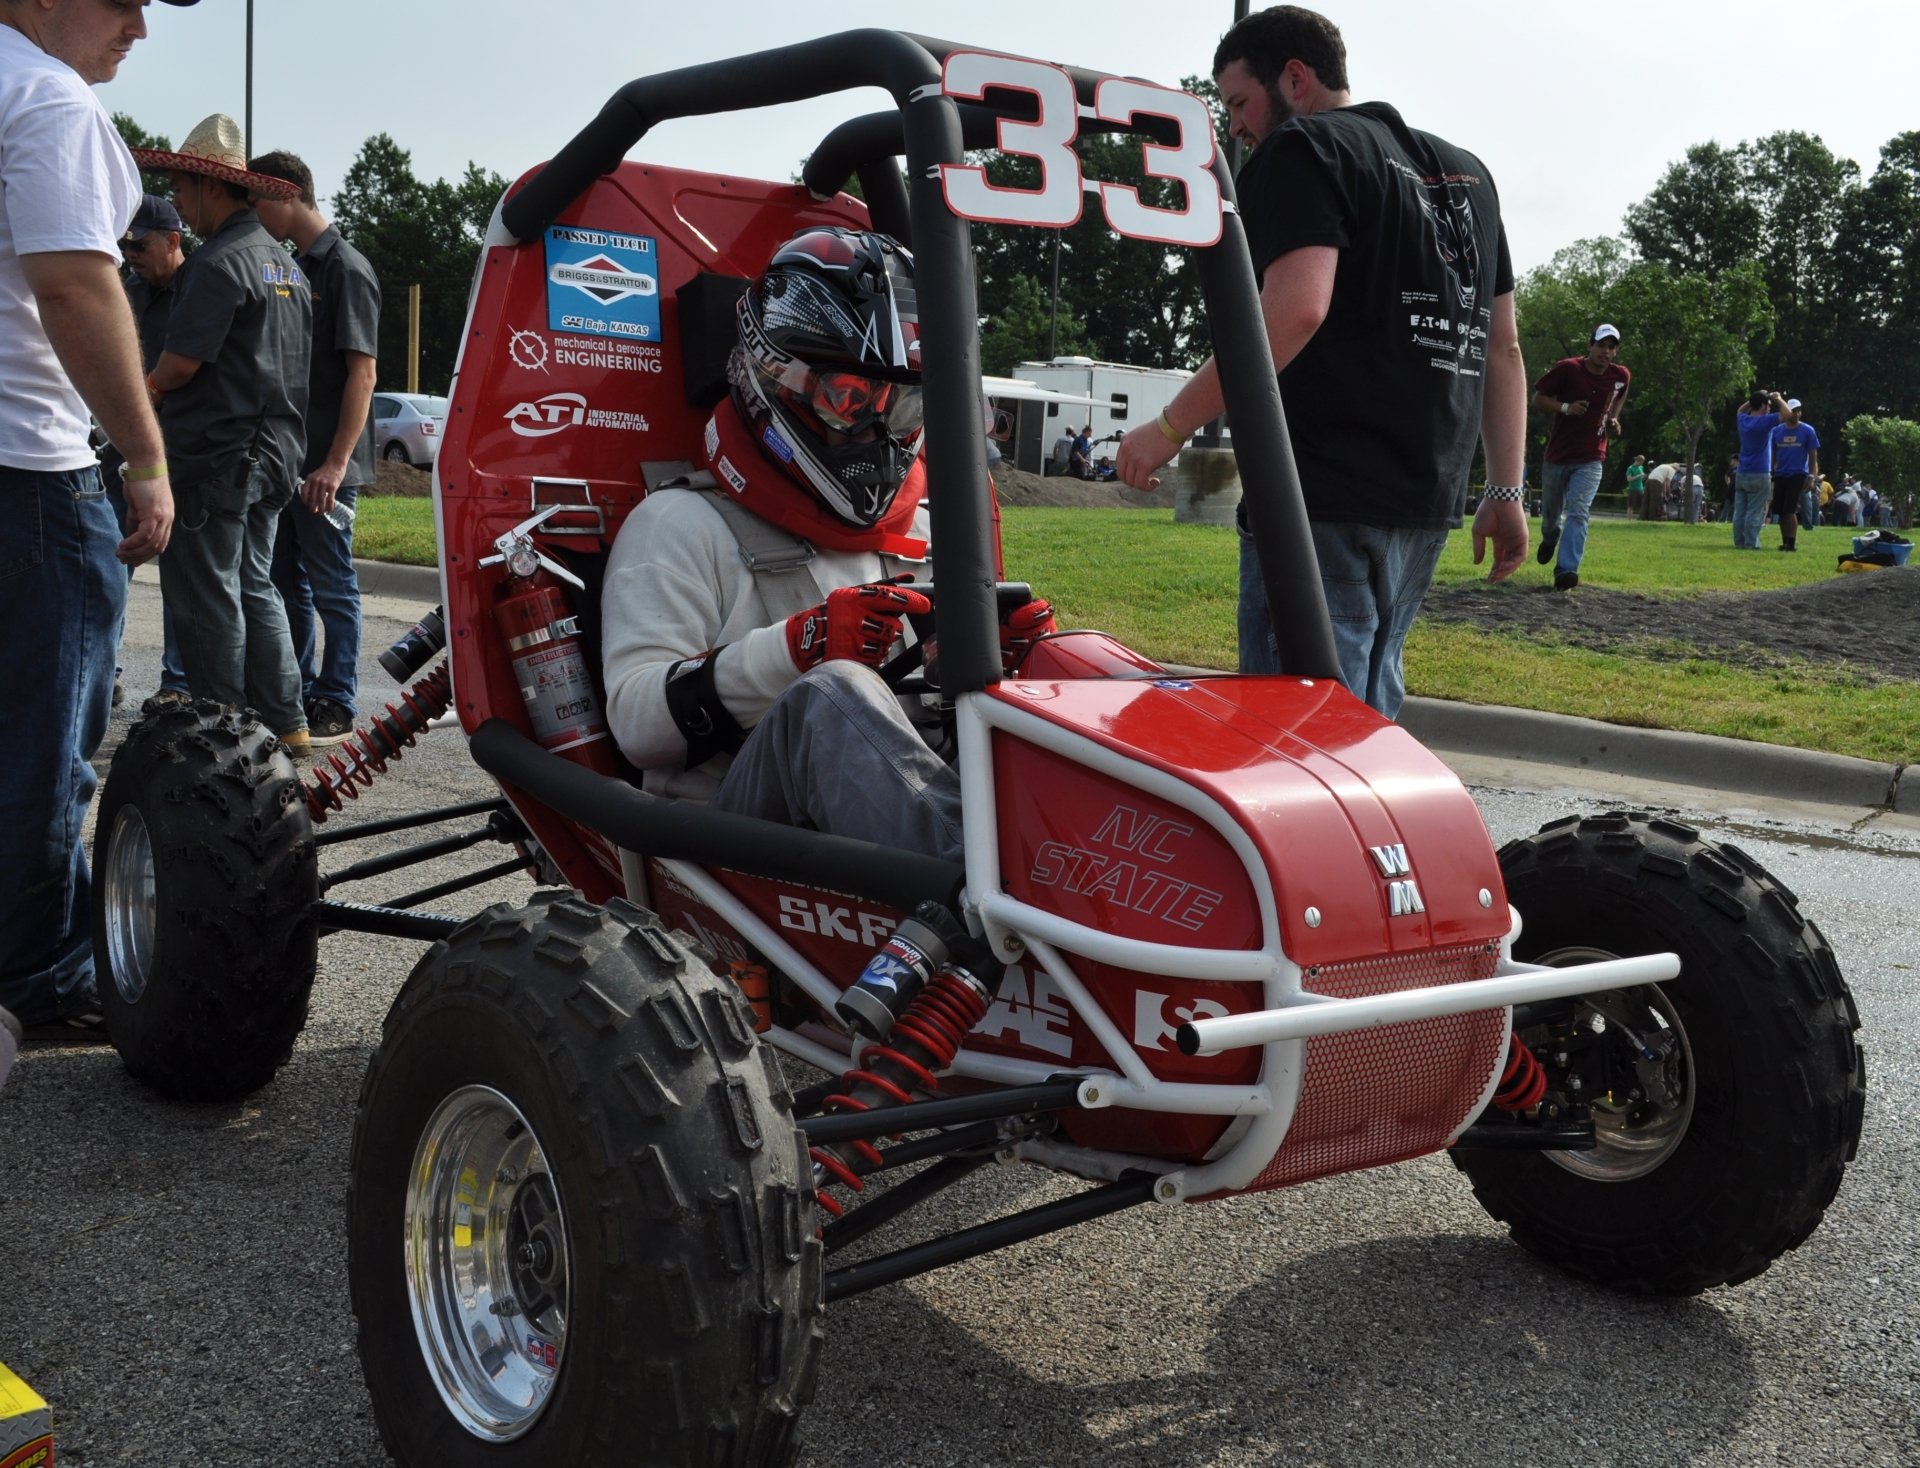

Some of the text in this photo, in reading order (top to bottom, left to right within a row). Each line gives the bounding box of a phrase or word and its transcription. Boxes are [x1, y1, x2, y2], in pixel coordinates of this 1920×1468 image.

[941, 50, 1223, 247] 33
[552, 228, 649, 252] PASSED TECH
[562, 316, 649, 336] SAE Baja KANSAS
[554, 337, 661, 358] mechanical & aerospace
[555, 350, 662, 374] ENGINEERING
[503, 402, 587, 426] ATI
[586, 417, 650, 432] AUTOMATION
[588, 409, 646, 423] INDUSTRIAL
[1091, 804, 1194, 863] NC
[1030, 840, 1224, 931] STATE
[778, 894, 897, 947] SKF
